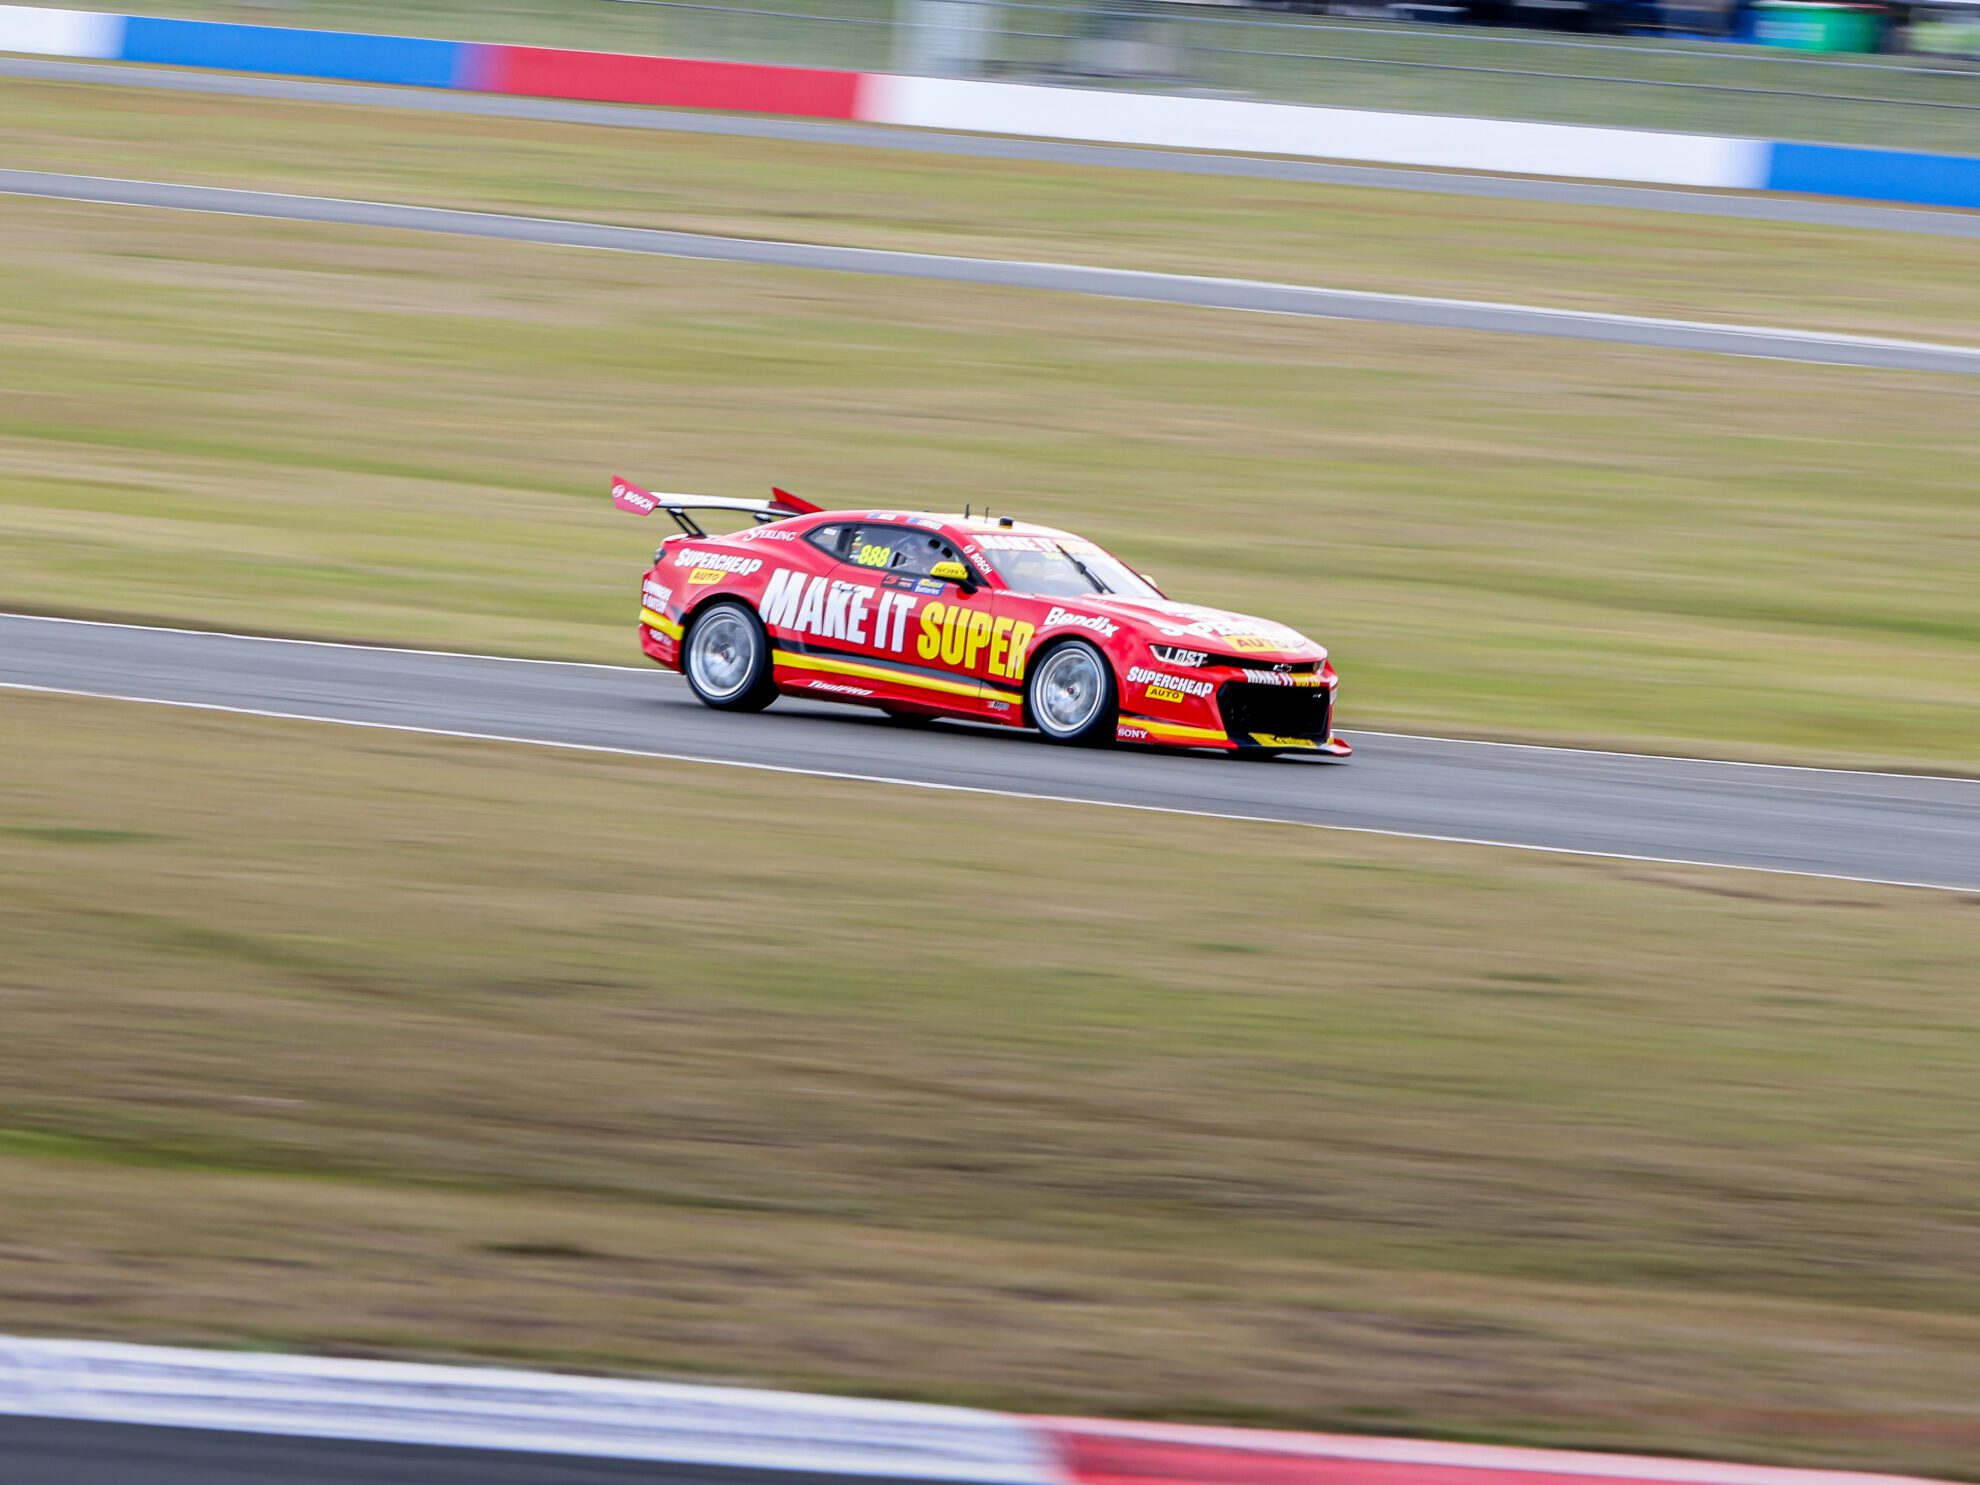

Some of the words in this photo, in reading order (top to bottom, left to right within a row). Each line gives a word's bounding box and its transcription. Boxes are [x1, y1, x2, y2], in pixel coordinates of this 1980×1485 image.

[623, 491, 655, 511] BOSCH
[674, 548, 763, 576] SUPERCHEAP
[858, 544, 891, 568] 888
[970, 553, 993, 575] BOSCH
[693, 571, 720, 581] AUTO
[914, 585, 940, 596] Batteries
[759, 567, 876, 645] MAKE
[874, 590, 918, 653] IT
[917, 601, 1035, 681] SUPER
[1043, 606, 1120, 638] Bendix
[1236, 638, 1290, 649] AUTO
[1126, 666, 1214, 698] SUPERCHEAP
[1149, 688, 1181, 700] AUTO
[1117, 728, 1148, 739] SONY
